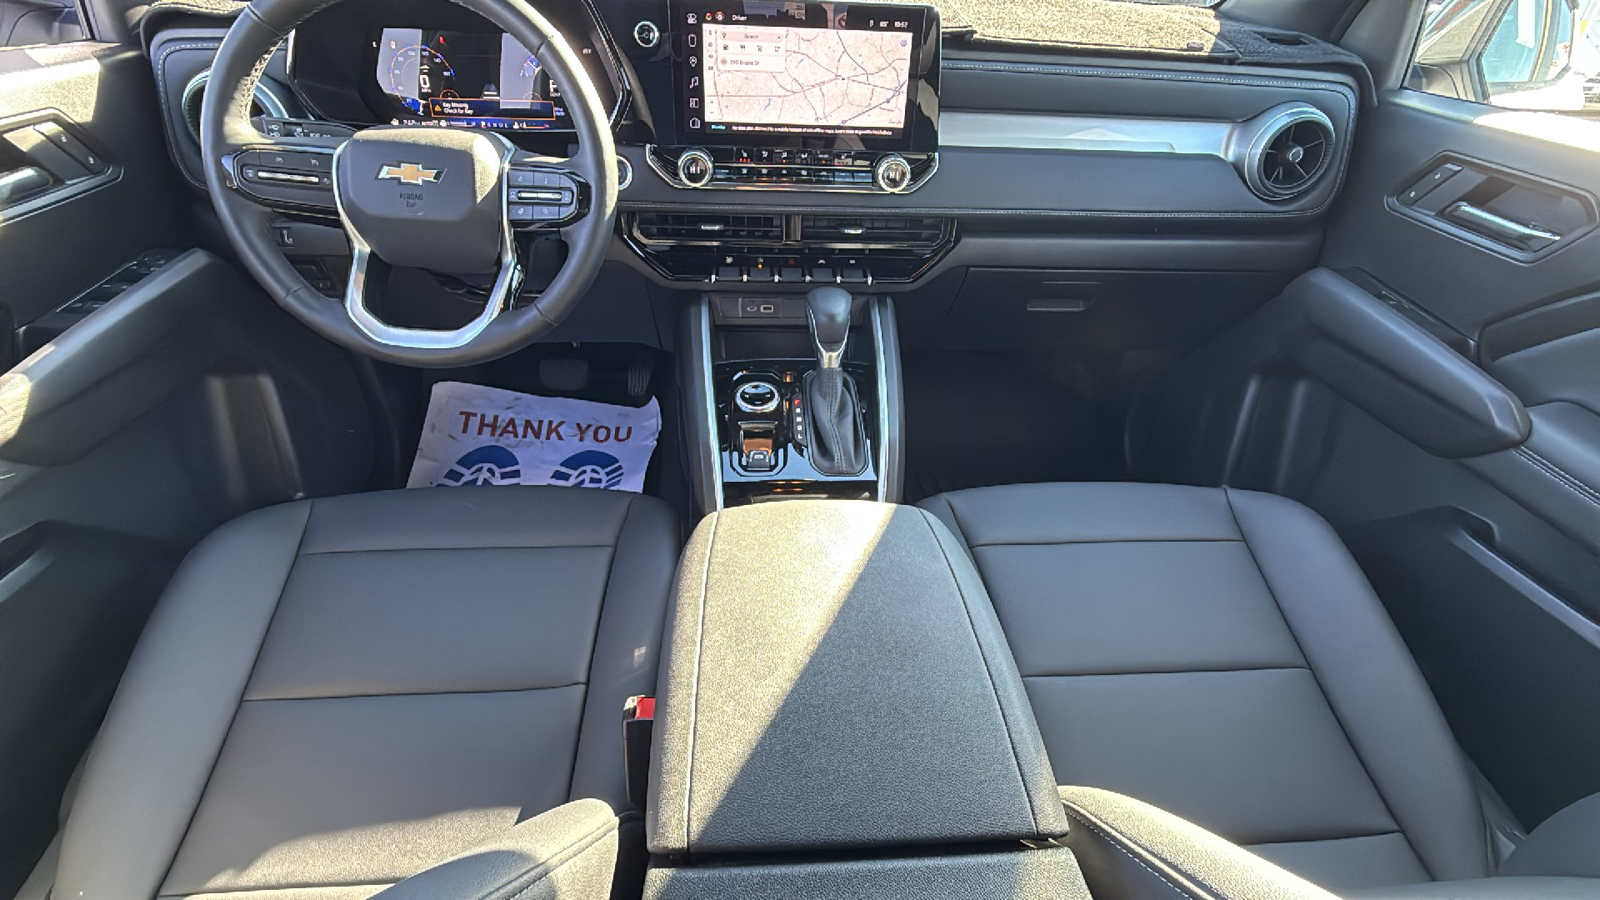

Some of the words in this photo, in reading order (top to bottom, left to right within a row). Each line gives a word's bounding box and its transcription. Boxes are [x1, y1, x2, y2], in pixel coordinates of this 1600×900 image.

[442, 101, 451, 109] Key
[690, 166, 700, 174] HI
[400, 192, 424, 200] AIRBAG
[459, 410, 566, 441] THANK
[575, 423, 633, 443] YOU
